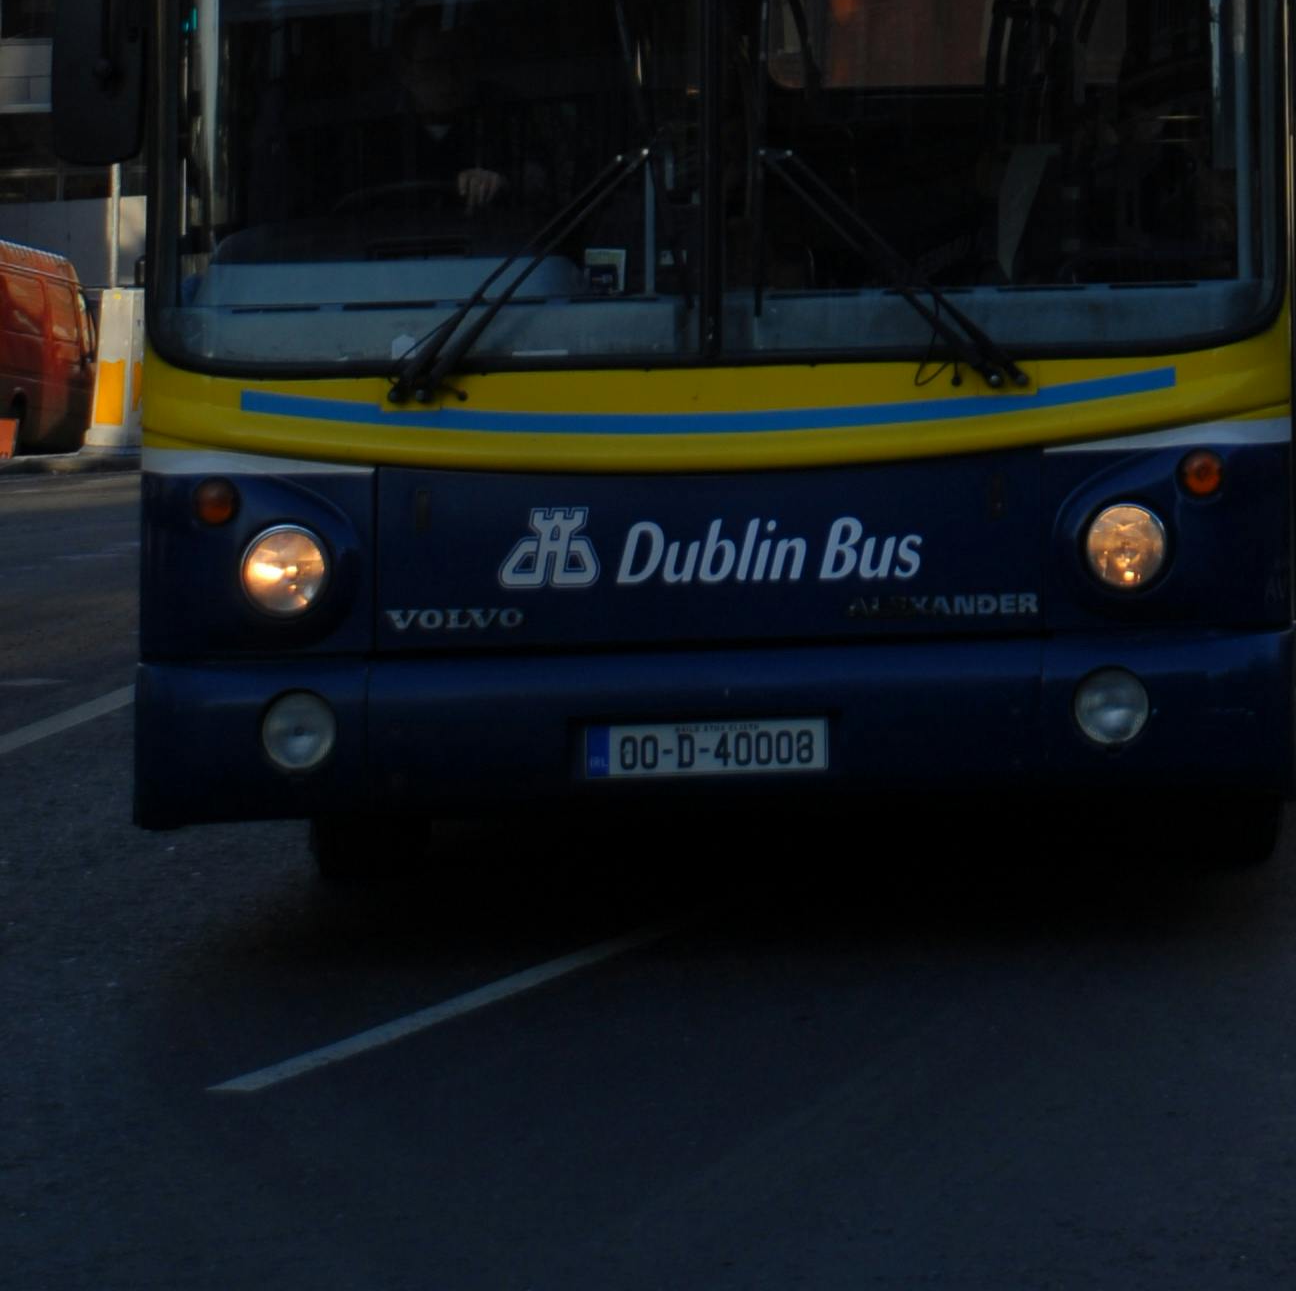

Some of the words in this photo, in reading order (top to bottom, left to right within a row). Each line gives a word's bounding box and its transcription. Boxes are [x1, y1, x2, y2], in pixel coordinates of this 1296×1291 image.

[616, 517, 808, 584] Dublin
[819, 515, 923, 580] Bus
[385, 607, 525, 629] VOLVO
[619, 729, 815, 771] 00-D-40008
